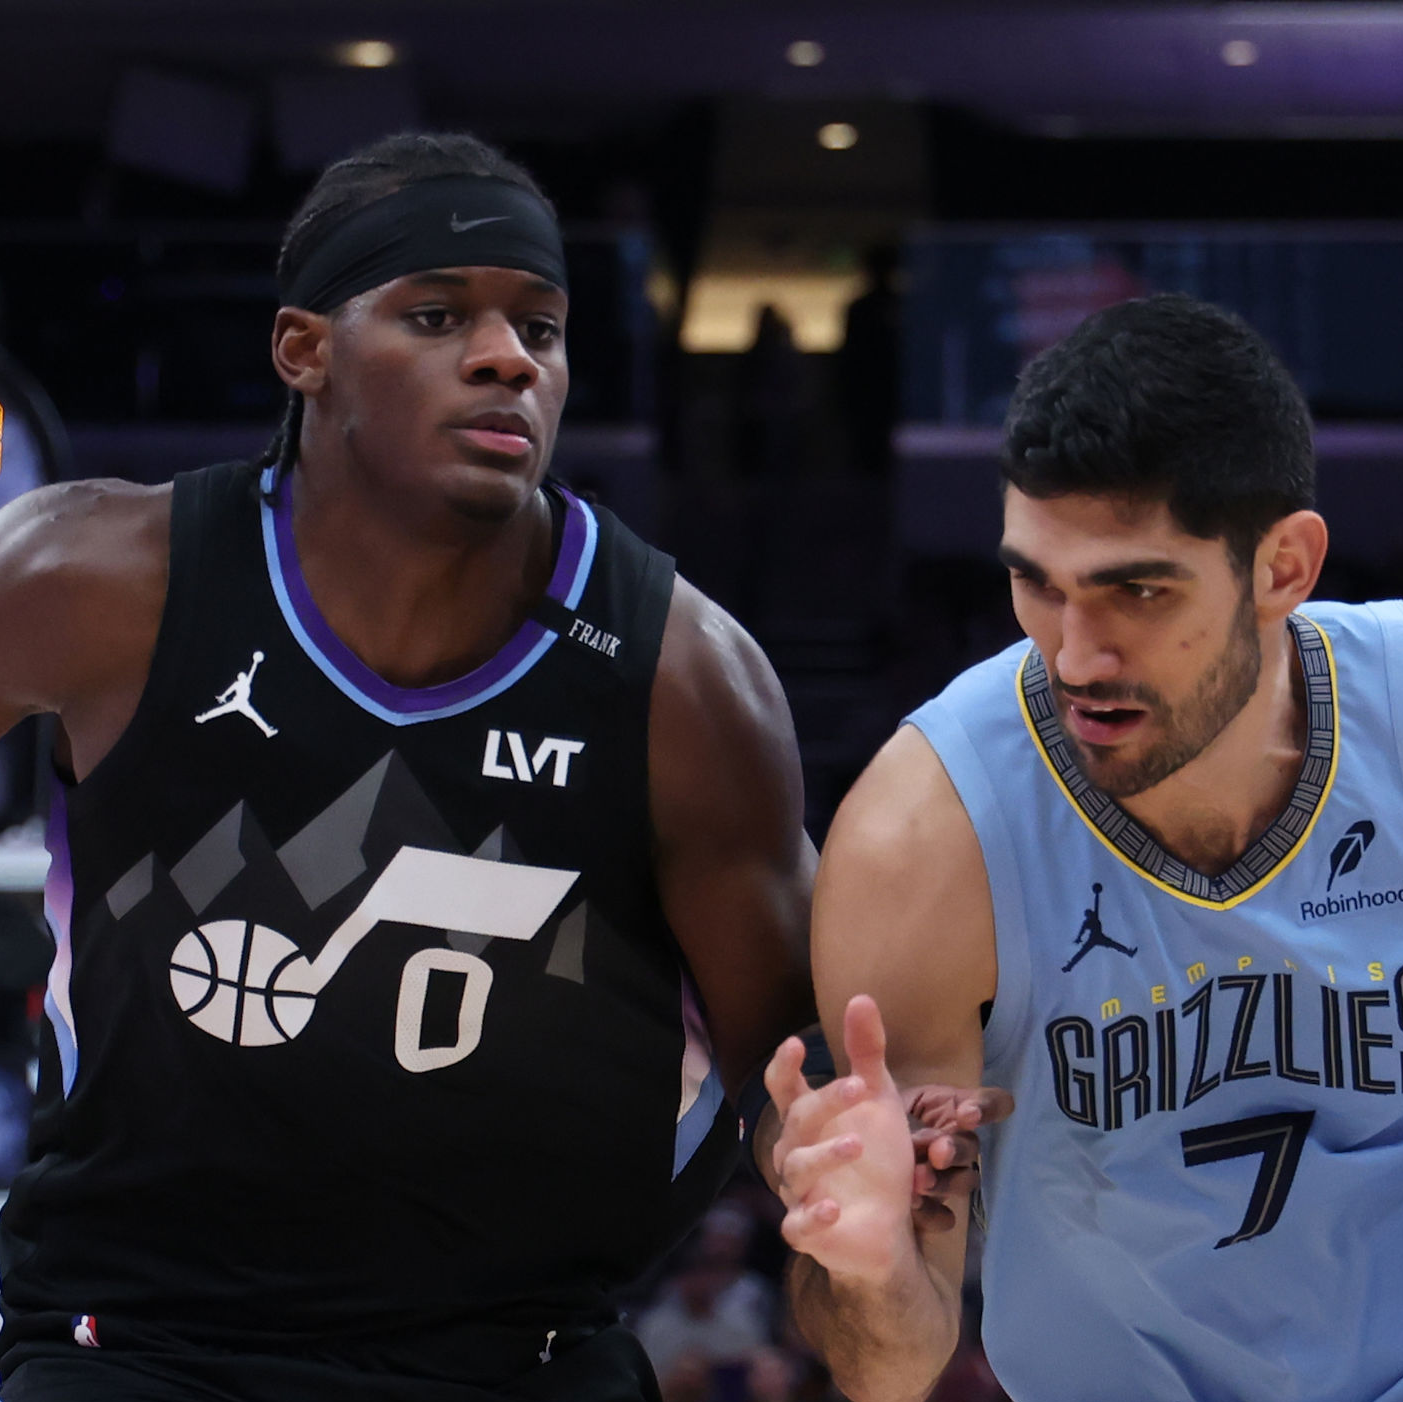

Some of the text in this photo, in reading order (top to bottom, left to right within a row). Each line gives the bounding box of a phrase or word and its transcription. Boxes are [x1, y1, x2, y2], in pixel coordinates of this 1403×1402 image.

[568, 618, 621, 658] FRANK
[482, 729, 586, 787] LVT
[395, 948, 494, 1073] 0
[1180, 1110, 1316, 1250] 7
